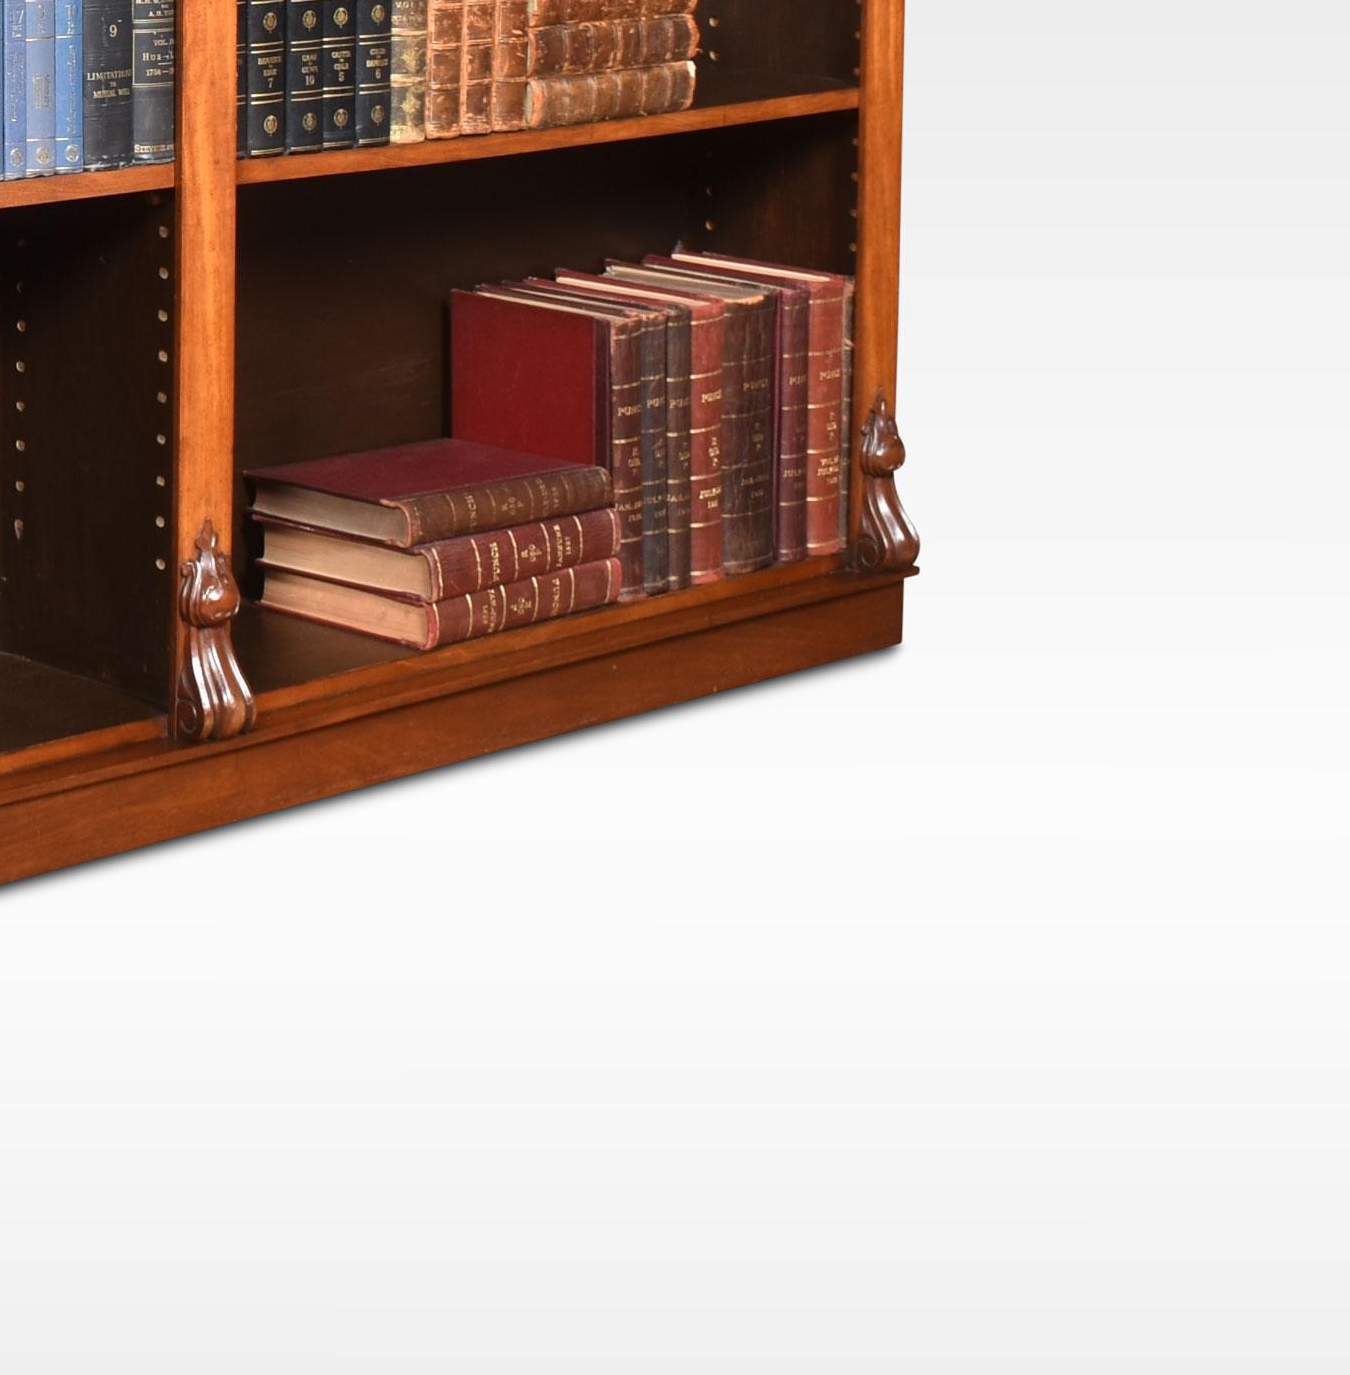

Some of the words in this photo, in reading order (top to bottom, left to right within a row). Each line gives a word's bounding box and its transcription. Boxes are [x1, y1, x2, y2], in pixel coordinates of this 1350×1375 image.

[109, 24, 118, 38] 9
[338, 72, 345, 82] 5
[375, 69, 382, 79] 6
[267, 77, 274, 88] 7
[305, 75, 315, 86] 10
